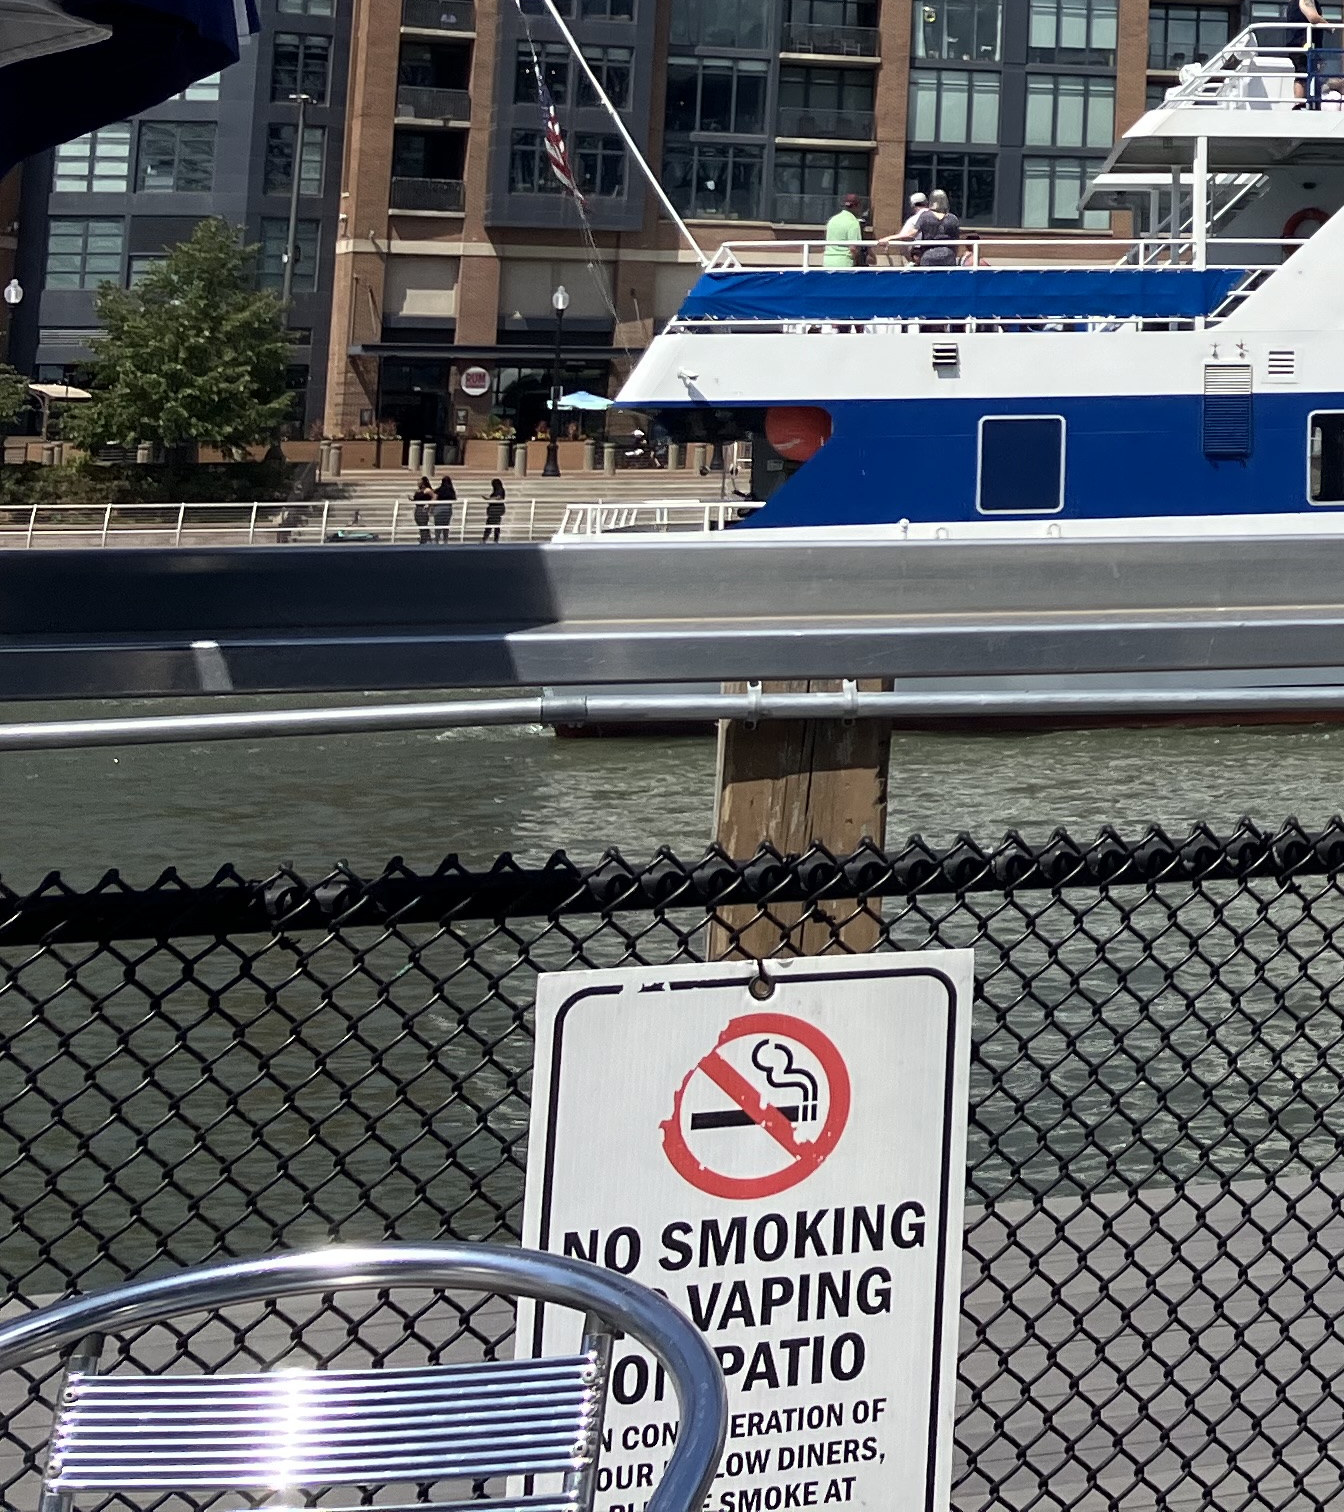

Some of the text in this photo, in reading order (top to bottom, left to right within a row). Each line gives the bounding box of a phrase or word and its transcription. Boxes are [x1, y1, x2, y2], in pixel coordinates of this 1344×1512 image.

[564, 1200, 927, 1276] NO SMOKING
[687, 1266, 892, 1331] VAPING
[713, 1331, 867, 1393] PATIO
[622, 1402, 844, 1451] CONERATION
[852, 1398, 888, 1425] OF
[597, 1463, 654, 1492] OUR
[778, 1436, 886, 1472] DINERS,
[720, 1481, 819, 1512] SMOKE
[824, 1476, 858, 1503] AT
